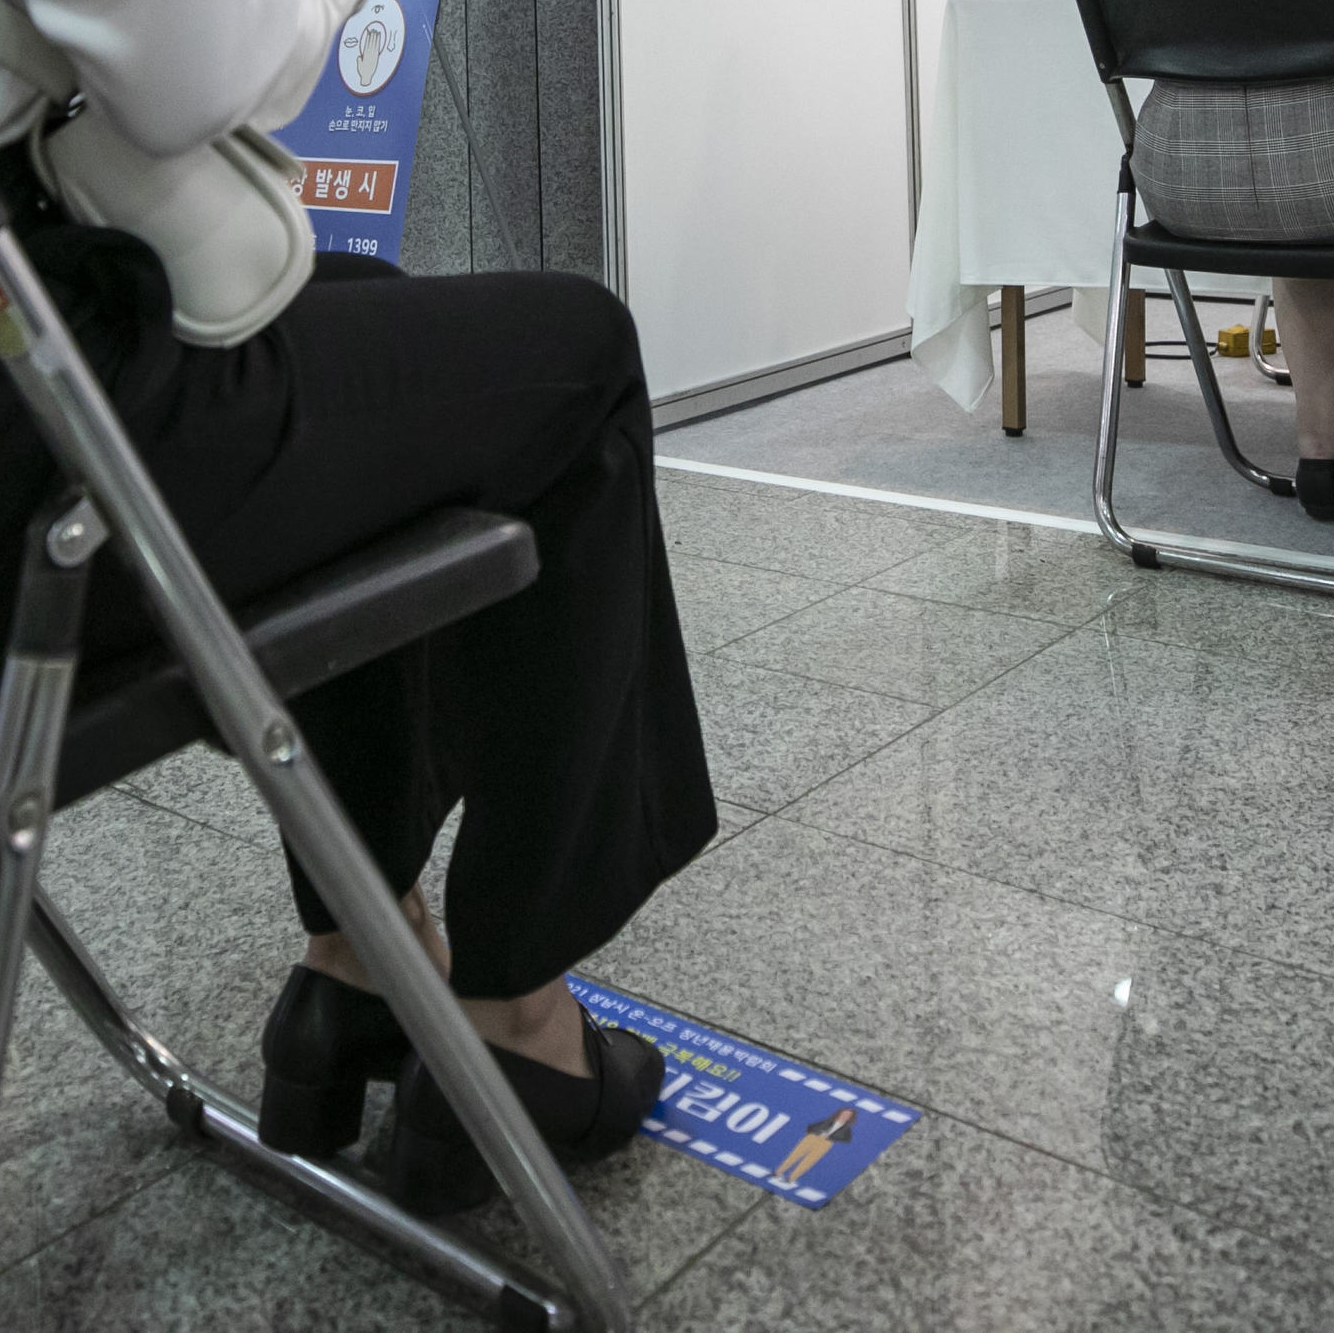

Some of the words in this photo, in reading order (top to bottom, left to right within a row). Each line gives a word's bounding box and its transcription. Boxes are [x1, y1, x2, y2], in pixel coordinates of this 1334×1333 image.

[328, 119, 349, 132] 손으로
[350, 119, 372, 132] 만지지
[288, 167, 307, 197] 상
[315, 168, 352, 200] 발생
[358, 170, 378, 201] 시
[347, 237, 378, 256] 1399
[588, 992, 630, 1015] 성남시
[628, 1009, 677, 1033] 온-오프
[679, 1029, 777, 1074] 청년채용박람회
